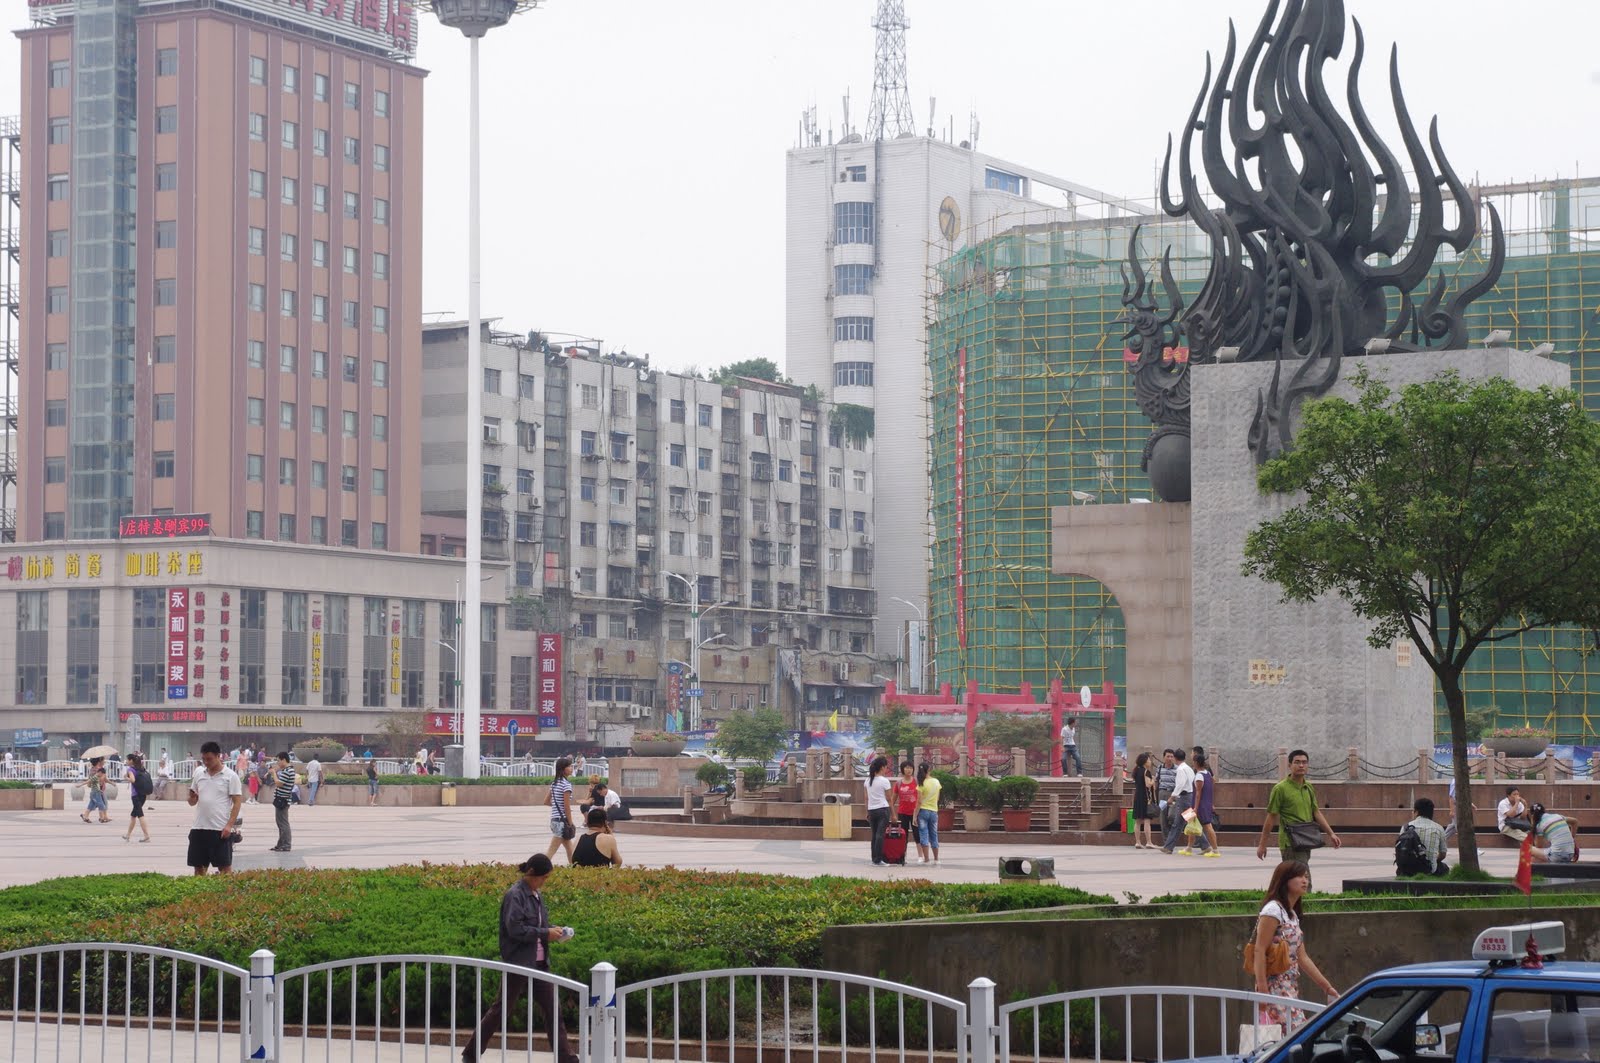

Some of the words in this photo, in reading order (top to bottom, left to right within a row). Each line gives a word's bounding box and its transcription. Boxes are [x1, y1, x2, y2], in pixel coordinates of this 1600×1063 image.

[126, 550, 203, 577] 咖啡茶座
[170, 592, 184, 681] 永和豆浆
[542, 638, 555, 713] 永和豆浆
